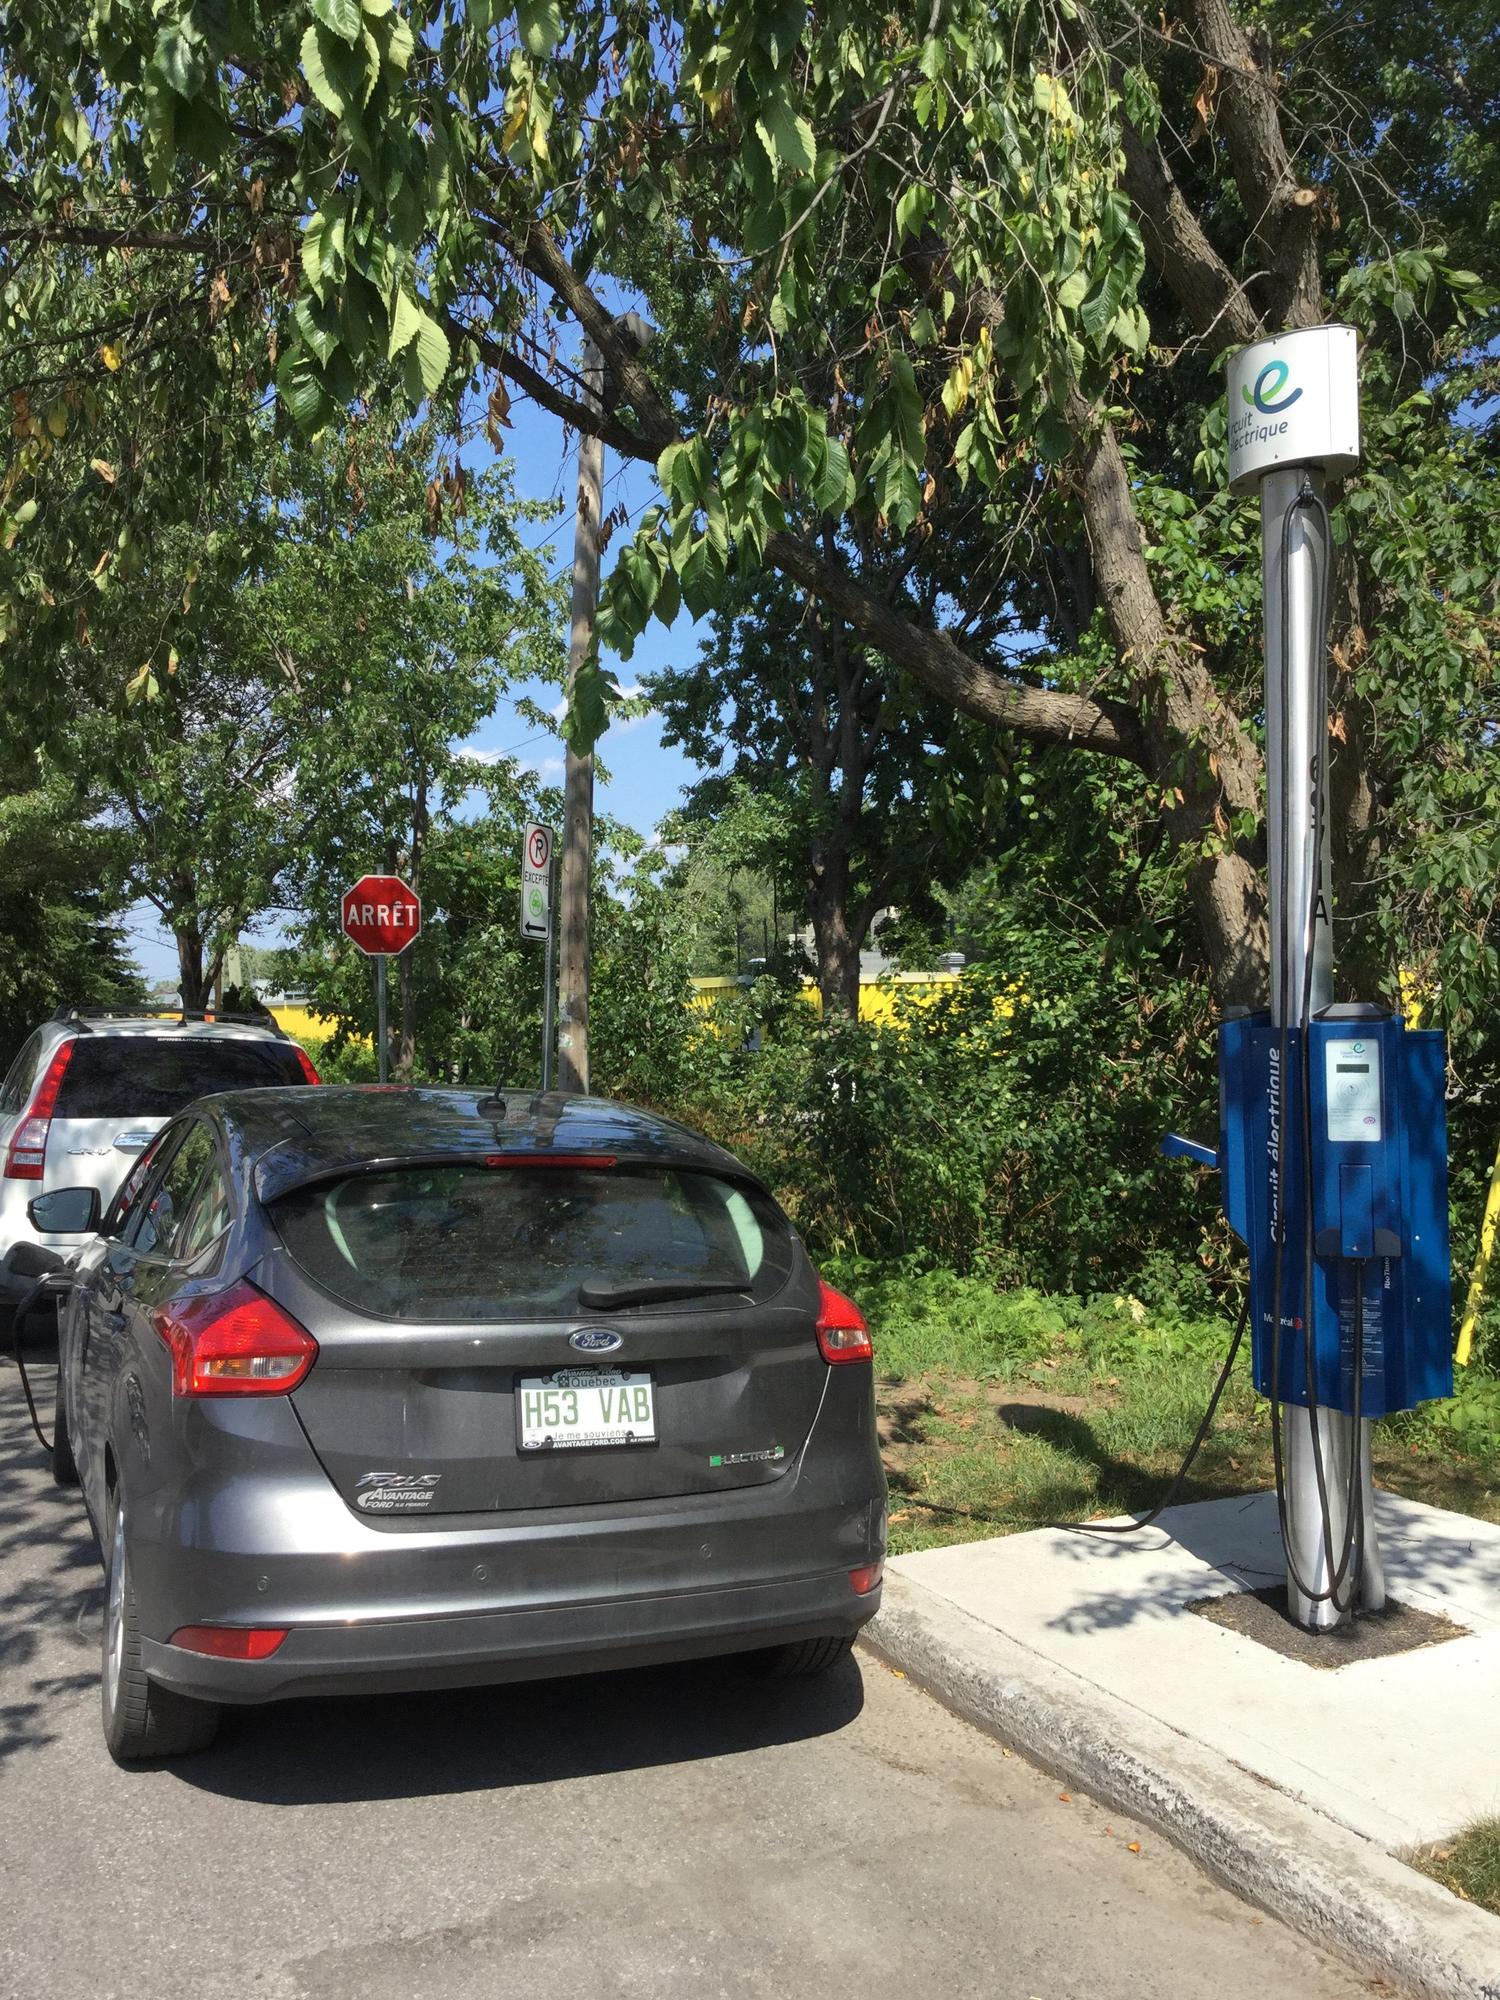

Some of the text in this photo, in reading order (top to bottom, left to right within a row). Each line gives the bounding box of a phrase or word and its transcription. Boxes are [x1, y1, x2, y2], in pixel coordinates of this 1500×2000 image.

[346, 900, 417, 927] ARRÊT
[580, 1333, 611, 1347] Ford
[524, 1386, 650, 1428] H53 VAB
[567, 1431, 580, 1440] me
[583, 1429, 627, 1439] souviens
[552, 1437, 627, 1449] AVANTAGEFORD.COM
[368, 1487, 435, 1501] AVANTAGE
[364, 1501, 394, 1509] FORD
